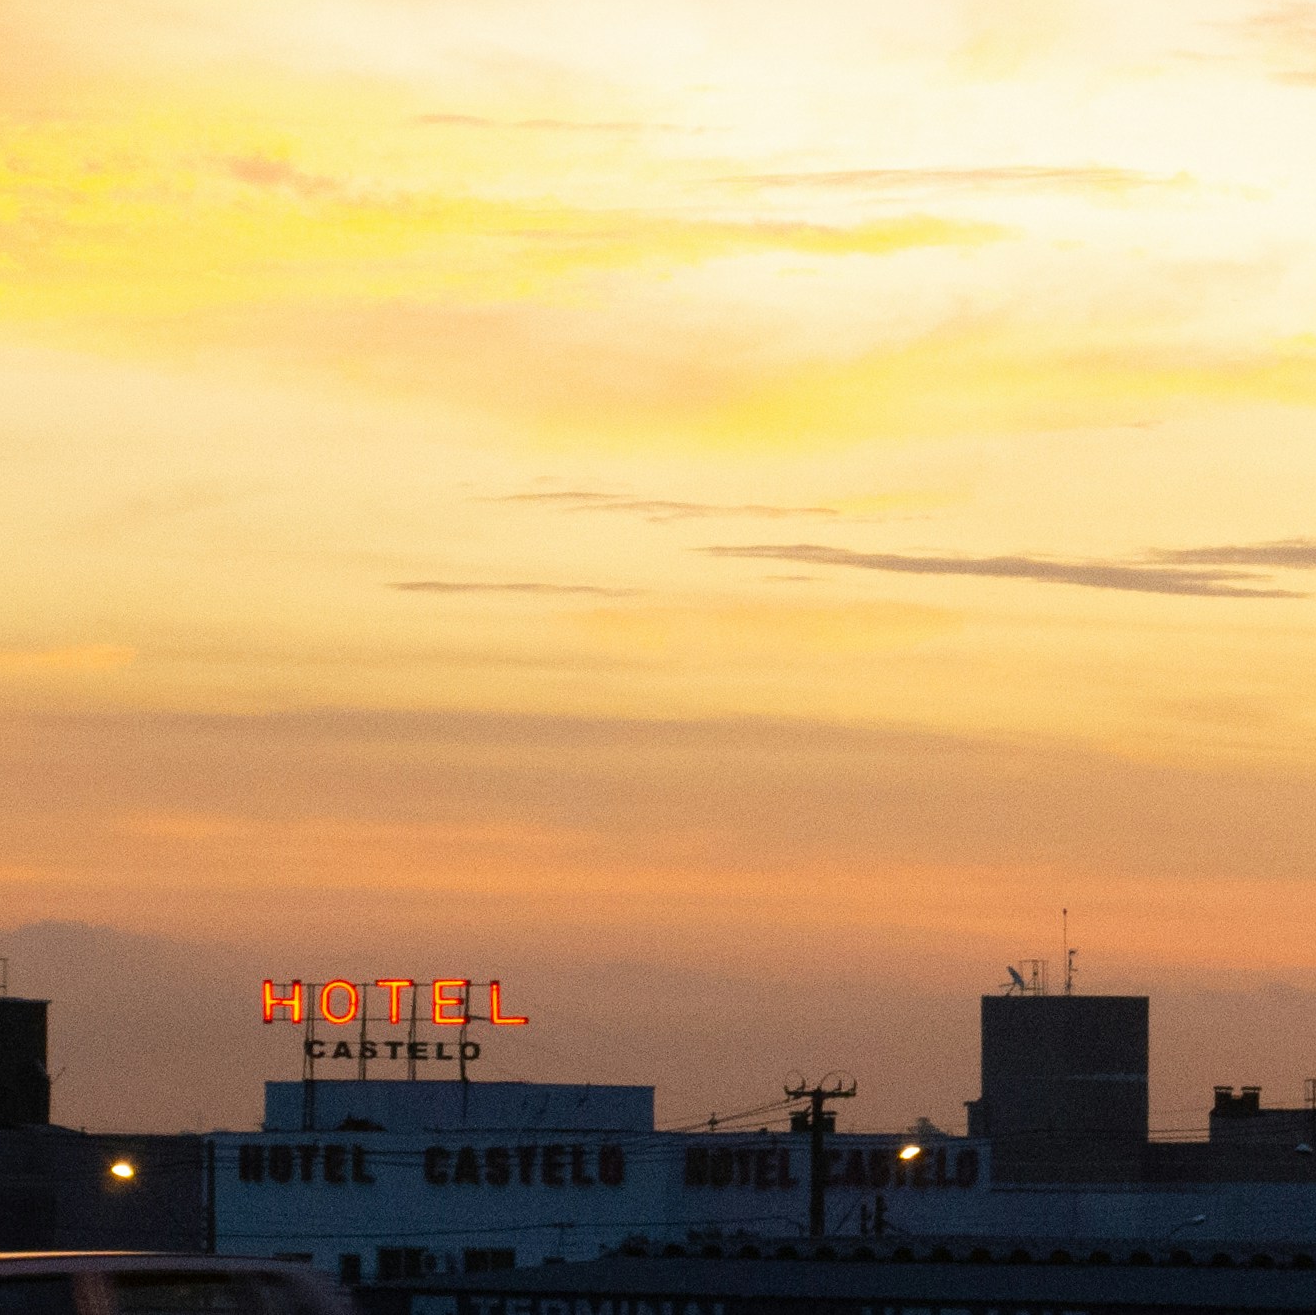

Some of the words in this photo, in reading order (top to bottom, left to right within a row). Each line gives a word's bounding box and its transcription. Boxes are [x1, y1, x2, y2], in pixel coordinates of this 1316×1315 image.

[262, 978, 529, 1025] HOTEL
[304, 1040, 481, 1061] CASTELO
[238, 1143, 375, 1185] HOTEL
[423, 1144, 626, 1186] CASTELO
[685, 1145, 800, 1189] HOTEL
